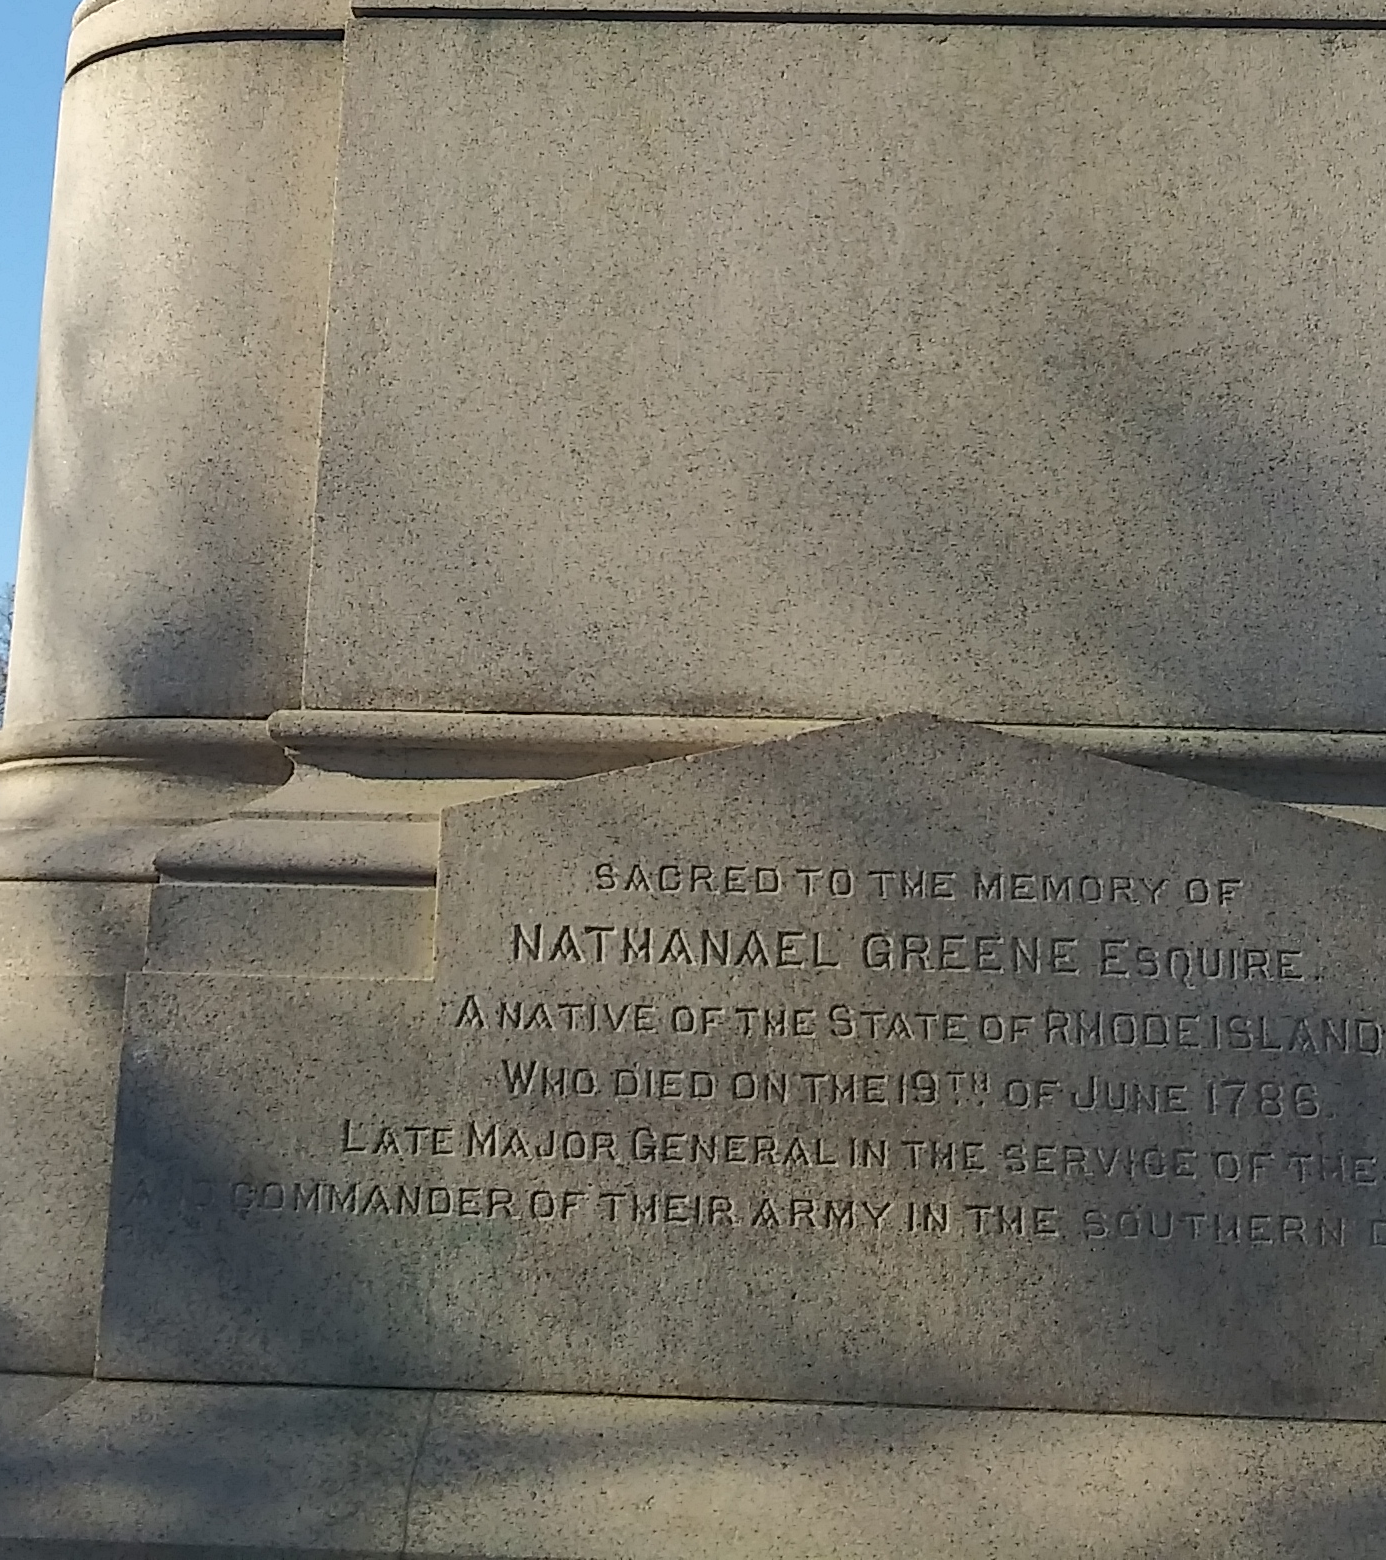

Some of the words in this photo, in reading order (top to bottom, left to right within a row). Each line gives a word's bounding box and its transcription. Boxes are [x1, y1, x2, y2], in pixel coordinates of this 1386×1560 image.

[595, 862, 782, 895] SACRED
[796, 868, 854, 898] TO
[869, 870, 956, 902] THE
[974, 872, 1170, 905] MEMORY
[1185, 877, 1243, 907] OF
[512, 924, 841, 970] NATHANAEL
[863, 932, 1080, 978] GREENE
[455, 995, 485, 1029] A
[497, 1000, 657, 1033] NATIVE
[671, 1004, 729, 1035] OF
[734, 1007, 817, 1038] THE
[828, 1006, 968, 1042] STATE
[983, 1015, 1036, 1043] OF
[1046, 1009, 1210, 1049] RHODE
[502, 1059, 597, 1098] WHO
[614, 1069, 715, 1099] DIED
[731, 1071, 787, 1103] ON
[806, 1074, 889, 1104] THE
[1004, 1078, 1063, 1109] OF
[1070, 1077, 1189, 1113] JUNE
[342, 1118, 454, 1156] LATE
[467, 1123, 616, 1161] MAJOR
[631, 1126, 838, 1168] GENERAL
[849, 1137, 889, 1170] IN
[907, 1142, 987, 1173] THE
[1004, 1144, 1199, 1180] SERVICE
[1213, 1150, 1275, 1182] OF
[1288, 1154, 1378, 1184] THE
[231, 1181, 514, 1219] COMMANDER
[529, 1189, 591, 1220] OF
[599, 1191, 736, 1226] THEIR
[751, 1198, 890, 1231] ARMY
[907, 1200, 951, 1233] IN
[965, 1205, 1060, 1237] THE
[1082, 1210, 1350, 1249] SOUTHERN
